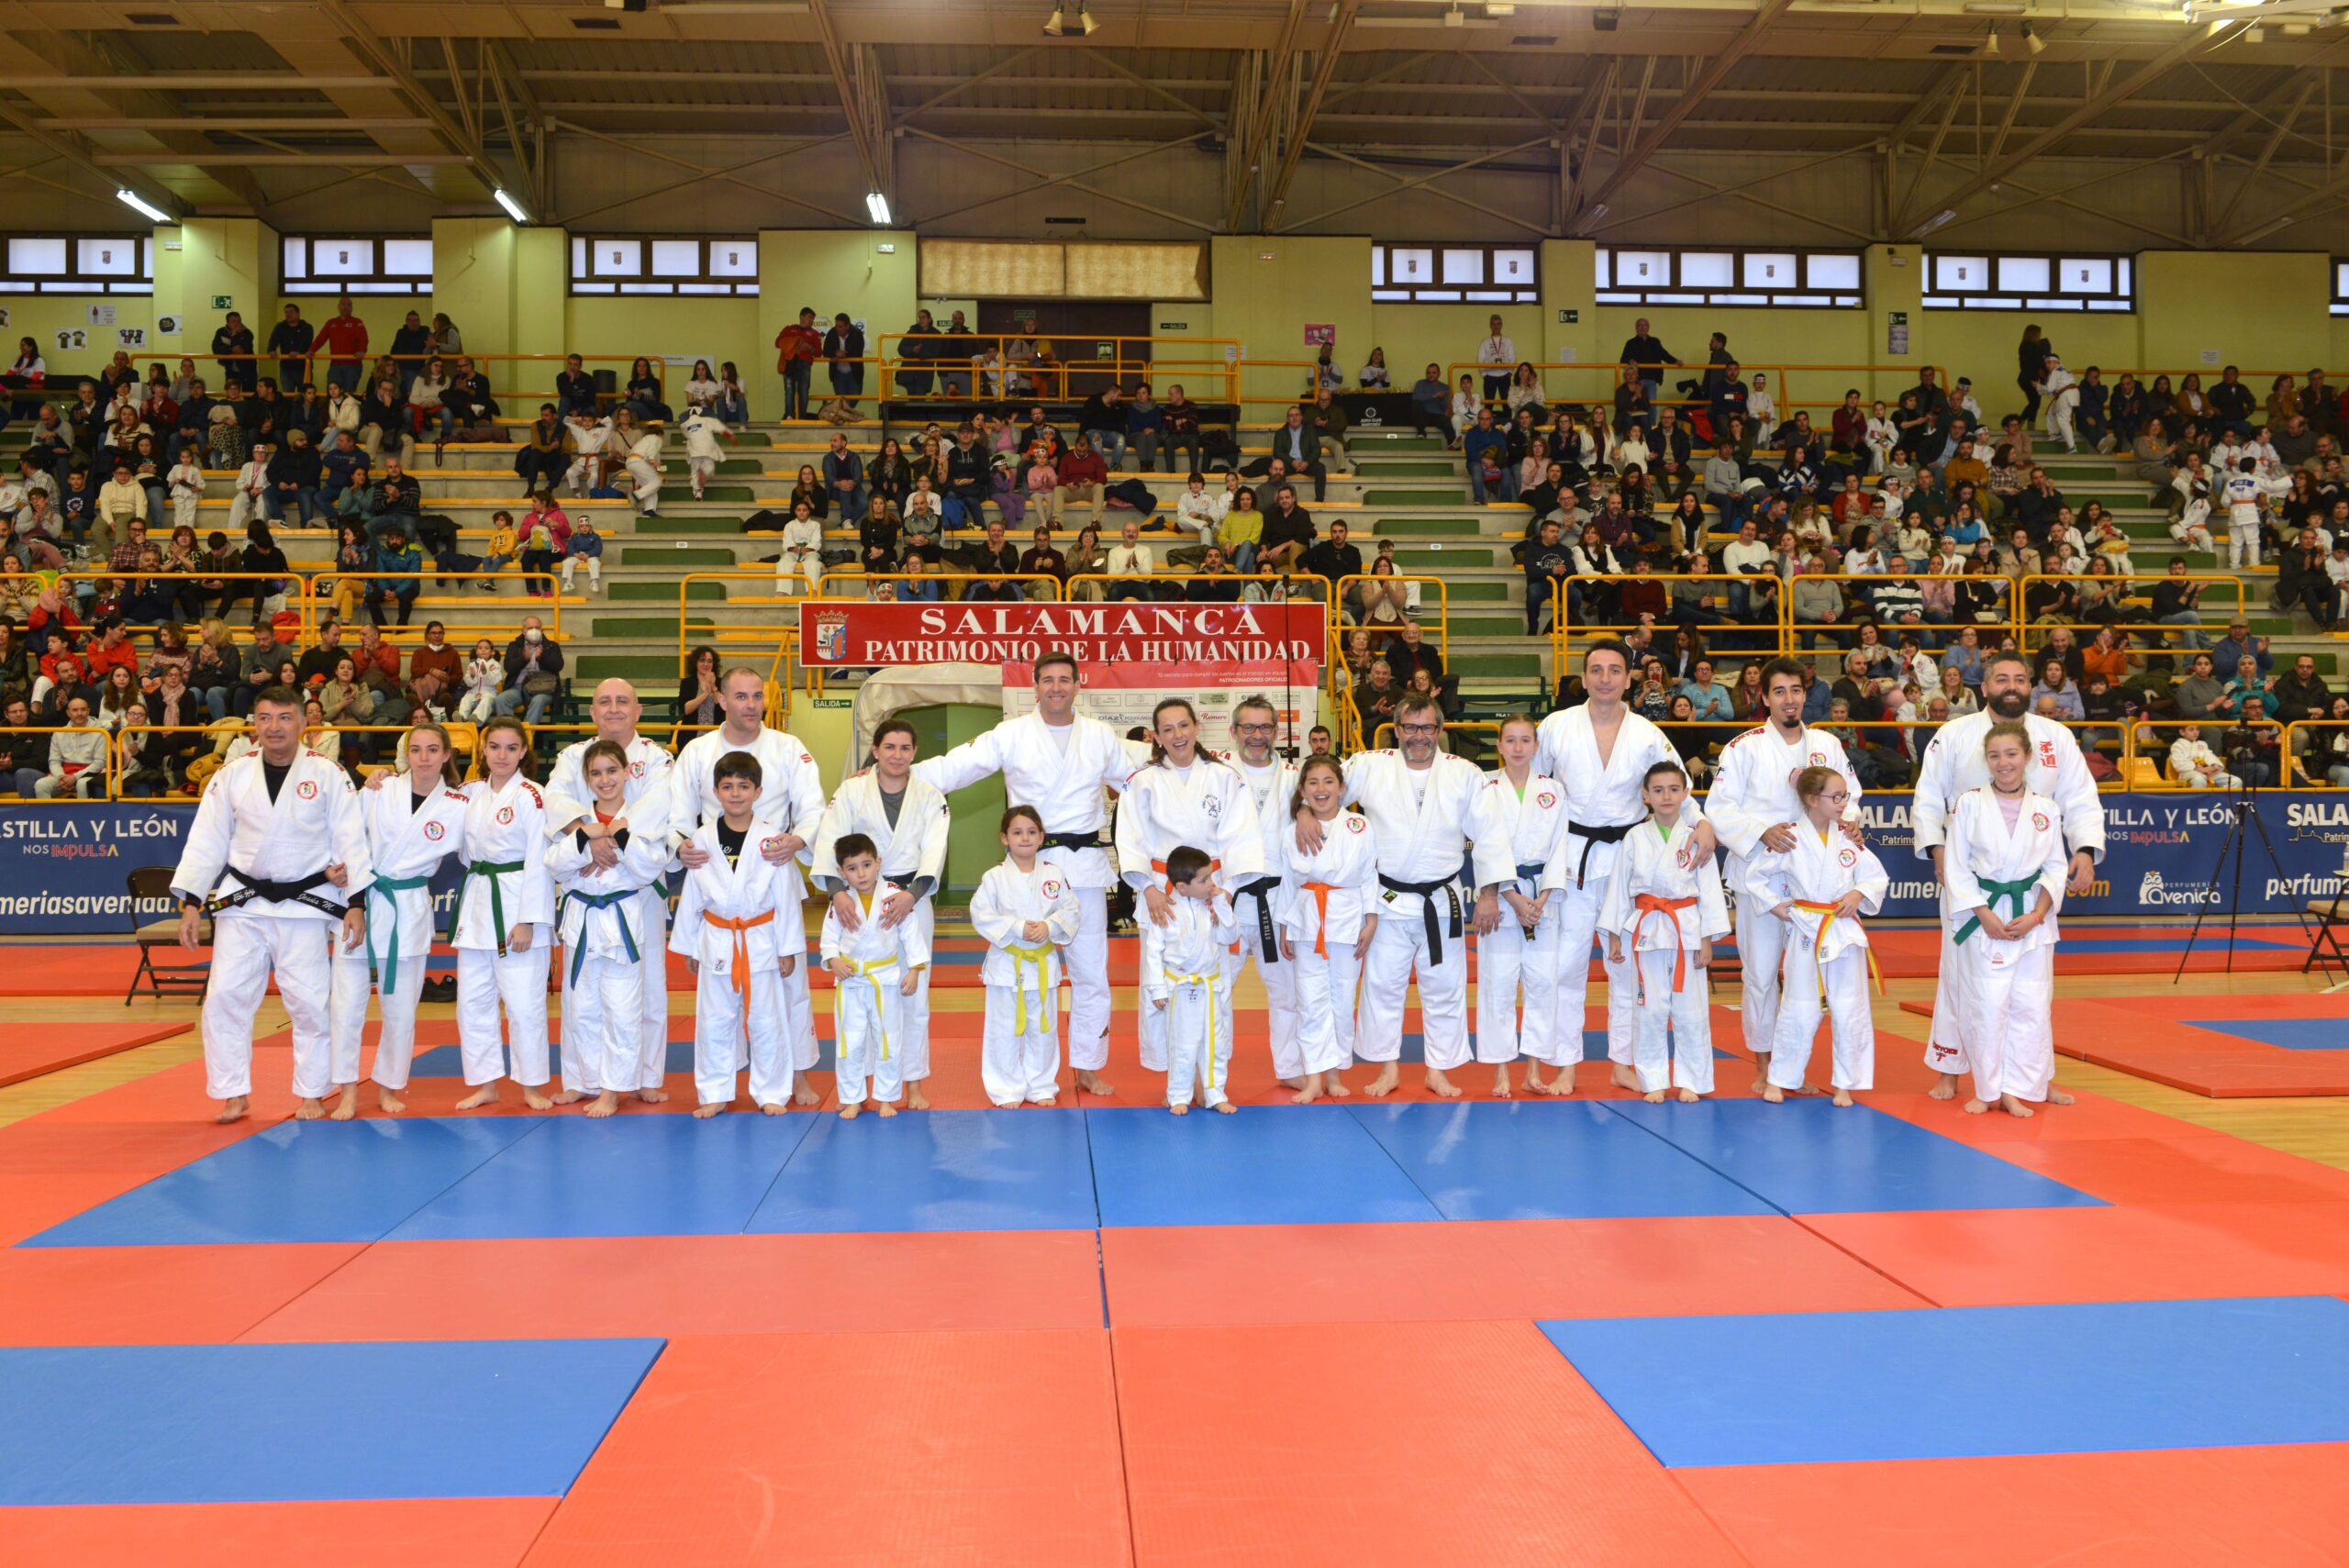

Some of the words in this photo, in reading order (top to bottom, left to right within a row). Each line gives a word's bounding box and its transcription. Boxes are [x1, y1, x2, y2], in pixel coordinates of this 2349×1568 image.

[920, 608, 1265, 636] SALAMANCA
[864, 639, 1041, 662] PATRIMONIO
[1051, 639, 1088, 662] DE
[1097, 639, 1132, 662] LA
[1141, 639, 1310, 662] HUMANIDAD
[1200, 712, 1228, 720] Romero
[2165, 808, 2179, 828] Y
[2186, 803, 2240, 826] LEÓN
[90, 819, 106, 842] Y
[116, 813, 177, 838] LEÓN
[23, 844, 50, 854] NOS
[296, 893, 320, 906] Jesús
